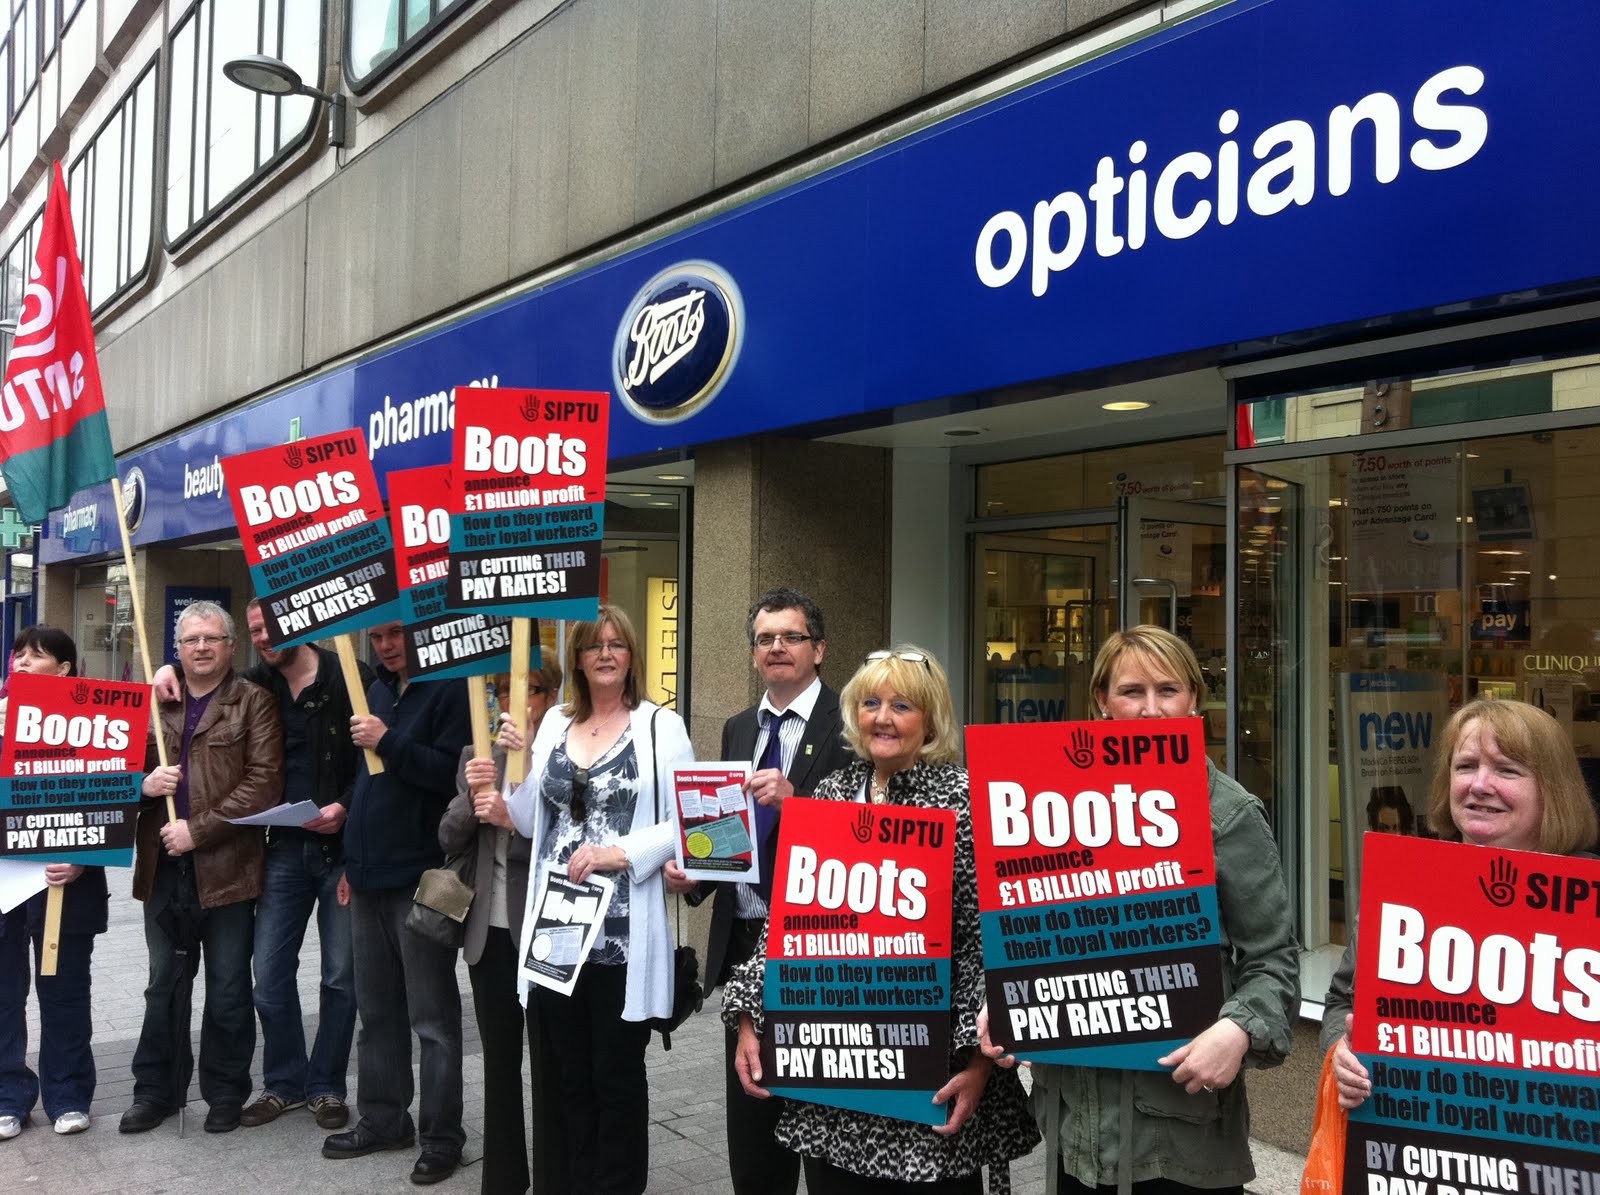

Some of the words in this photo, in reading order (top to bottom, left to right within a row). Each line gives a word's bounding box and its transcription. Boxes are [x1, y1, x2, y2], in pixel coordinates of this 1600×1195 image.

[975, 65, 1489, 297] opticians
[623, 289, 706, 391] Boots
[369, 375, 498, 461] pharm
[544, 401, 599, 423] SIPTU
[305, 437, 357, 464] SIPTU
[464, 426, 587, 477] Boots
[1387, 461, 1412, 470] worth
[1414, 459, 1423, 467] of
[1425, 456, 1452, 468] points
[184, 455, 225, 499] beauty
[464, 475, 530, 492] announce
[239, 470, 360, 526] Boots
[464, 494, 482, 511] £1
[485, 488, 540, 511] BILLION
[542, 486, 586, 506] profit
[1352, 506, 1375, 516] That's
[1377, 505, 1391, 514] 750
[1393, 503, 1418, 513] points
[1420, 503, 1432, 511] on
[63, 503, 98, 538] pharmacy
[253, 514, 314, 544] announce
[257, 541, 277, 560] £1
[275, 522, 328, 554] BILLION
[326, 508, 368, 535] profit
[463, 517, 491, 531] How
[494, 514, 511, 529] do
[513, 512, 543, 527] they
[546, 506, 593, 523] reward
[1351, 518, 1368, 528] your
[1414, 513, 1437, 522] Card!
[262, 563, 289, 577] How
[290, 551, 306, 566] do
[308, 541, 334, 556] they
[336, 523, 379, 546] reward
[464, 532, 496, 547] their
[500, 528, 532, 545] loyal
[534, 522, 598, 541] workers?
[267, 572, 298, 590] their
[298, 557, 330, 578] loyal
[331, 535, 387, 566] workers?
[409, 566, 426, 584] £1
[460, 560, 478, 577] BY
[480, 554, 542, 575] CUTTING
[544, 551, 586, 569] THEIR
[271, 597, 290, 616] BY
[289, 576, 348, 609] CUTTING
[345, 561, 386, 586] THEIR
[461, 576, 497, 601] PAY
[500, 570, 567, 598] RATES!
[174, 598, 222, 606] wele
[277, 607, 312, 636] PAY
[312, 583, 376, 622] RATES!
[414, 628, 430, 646] BY
[431, 614, 486, 641] CUTTING
[1482, 613, 1517, 631] pay
[417, 641, 448, 668] PAY
[450, 625, 510, 660] RATES!
[1524, 655, 1600, 674] CLINIQU
[92, 688, 143, 708] SIPTU
[996, 697, 1066, 723] new
[16, 705, 130, 751] Boots
[1360, 711, 1433, 752] new
[14, 747, 76, 759] announce
[1102, 734, 1190, 766] SIPTU
[14, 761, 31, 775] £1
[33, 759, 84, 775] BILLION
[87, 757, 126, 773] profit
[693, 775, 727, 783] Management
[11, 779, 37, 792] How
[41, 778, 56, 790] do
[58, 777, 86, 790] they
[88, 774, 132, 788] reward
[11, 793, 41, 805] their
[44, 791, 75, 805] loyal
[77, 787, 137, 801] workers?
[6, 816, 24, 830] BY
[26, 812, 84, 829] CUTTING
[85, 810, 124, 825] THEIR
[988, 780, 1180, 849] Boots
[7, 829, 40, 850] PAY
[43, 826, 106, 847] RATES!
[878, 817, 944, 849] SIPTU
[995, 849, 1095, 879] announce
[785, 845, 928, 921] Boots
[999, 880, 1027, 907] £1
[1028, 869, 1113, 905] BILLION
[1115, 860, 1185, 896] profit
[1526, 872, 1600, 918] SIP
[783, 913, 859, 931] announce
[999, 913, 1041, 937] How
[1046, 909, 1071, 933] do
[1073, 904, 1121, 930] they
[1124, 891, 1202, 923] reward
[783, 933, 803, 957] £1
[805, 933, 870, 956] BILLION
[873, 933, 927, 958] profit
[1004, 937, 1052, 962] their
[1055, 931, 1106, 956] loyal
[1110, 917, 1212, 950] workers?
[779, 964, 813, 984] How
[814, 963, 835, 983] do
[837, 963, 873, 985] they
[875, 962, 937, 983] reward
[1377, 902, 1600, 1024] Boots
[780, 986, 818, 1006] their
[820, 986, 860, 1007] loyal
[862, 985, 945, 1006] workers?
[1003, 980, 1030, 1006] BY
[1034, 970, 1129, 1003] CUTTING
[1130, 962, 1199, 993] THEIR
[1009, 1005, 1063, 1042] PAY
[1067, 995, 1173, 1037] RATES!
[1376, 996, 1497, 1026] announce
[774, 1023, 796, 1046] BY
[798, 1022, 874, 1048] CUTTING
[876, 1023, 930, 1047] THEIR
[1377, 1022, 1407, 1054] £1
[1412, 1025, 1515, 1064] BILLION
[1521, 1038, 1600, 1071] profi
[775, 1048, 817, 1079] PAY
[821, 1048, 906, 1080] RATES!
[1372, 1062, 1421, 1090] How
[1427, 1068, 1458, 1094] do
[1462, 1071, 1520, 1105] they
[1526, 1080, 1600, 1111] rewa
[1374, 1092, 1430, 1123] their
[1435, 1098, 1499, 1133] loyal
[1503, 1110, 1600, 1145] worker
[1365, 1140, 1397, 1172] BY
[1402, 1145, 1519, 1192] CUTTING
